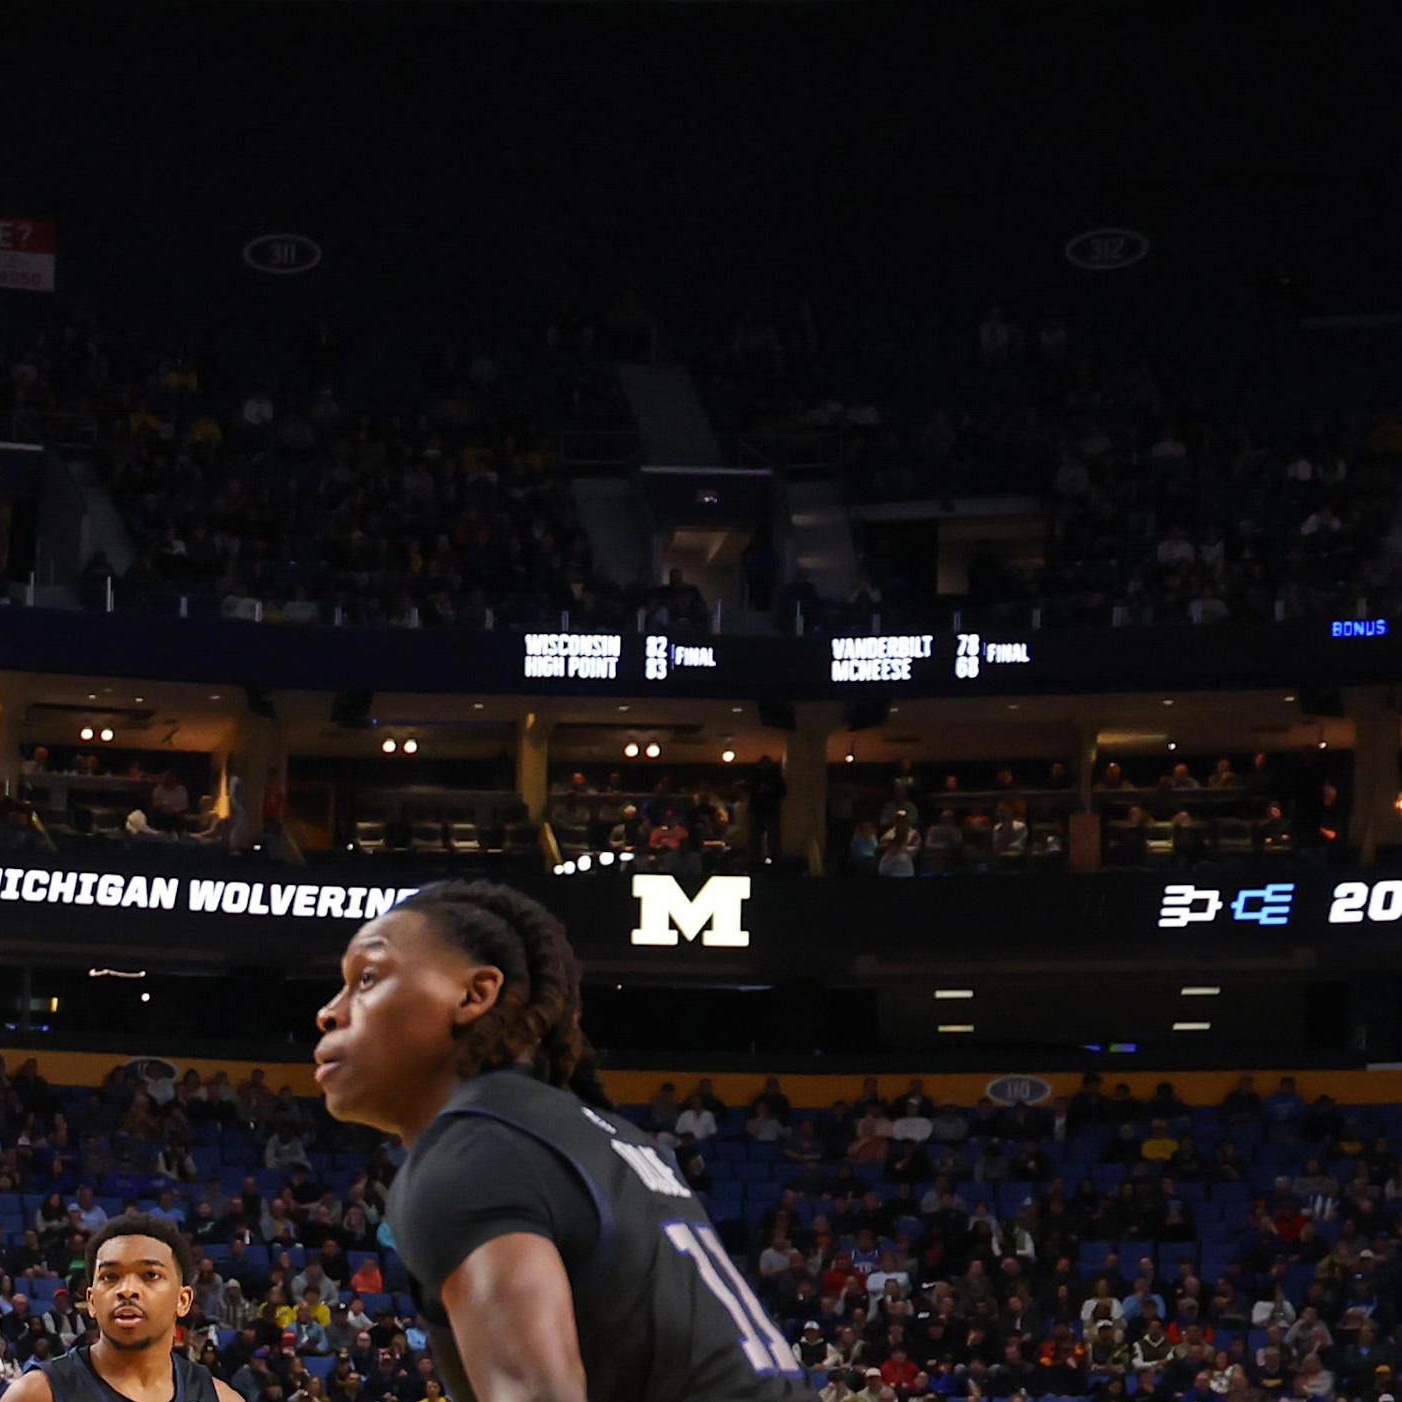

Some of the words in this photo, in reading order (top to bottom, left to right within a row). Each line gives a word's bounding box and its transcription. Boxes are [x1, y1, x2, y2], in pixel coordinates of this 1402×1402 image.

[1331, 619, 1387, 637] BONUS
[524, 633, 621, 657] WISCONSIN
[645, 635, 667, 657] 82
[676, 646, 716, 667] FINAL
[831, 634, 933, 660] VANDERBILT
[986, 643, 1030, 664] FINAL
[524, 656, 566, 679] HIGH
[568, 656, 618, 679] POINT
[645, 656, 667, 680] 83
[831, 658, 912, 682] MCNEESE
[188, 878, 421, 920] WOLVERIN
[630, 873, 752, 948] M
[1327, 880, 1402, 924] 20
[659, 1218, 802, 1376] 11
